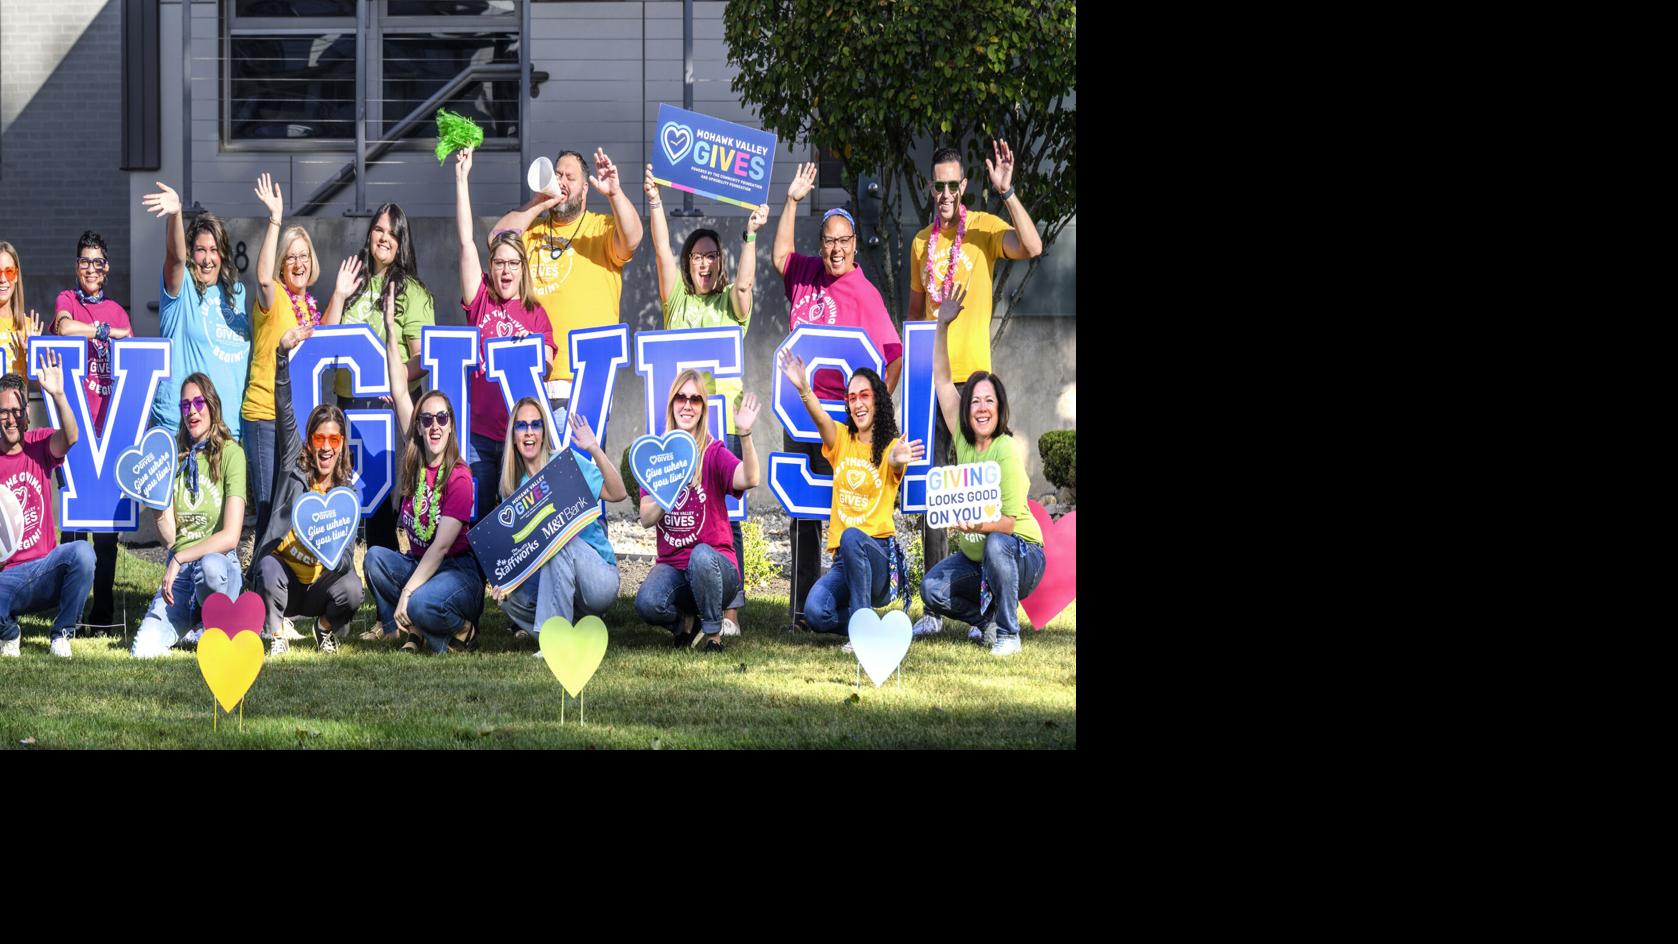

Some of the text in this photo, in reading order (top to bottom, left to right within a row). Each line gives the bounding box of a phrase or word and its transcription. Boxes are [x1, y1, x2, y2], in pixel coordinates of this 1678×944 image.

[697, 129, 768, 156] MOHAWK VALLEY
[694, 140, 766, 180] GIVES
[234, 240, 249, 273] 8
[90, 361, 112, 374] GIVE
[134, 474, 148, 494] Give
[148, 452, 170, 476] where
[144, 479, 158, 498] you
[156, 462, 170, 482] live!
[646, 460, 688, 483] Give where
[652, 468, 685, 492] you live!
[929, 466, 997, 490] GIVING
[512, 474, 545, 505] MOHAWK VALLEY
[514, 480, 550, 516] GIVES
[840, 493, 868, 508] GIVES
[929, 489, 998, 506] LOOKS GOOD
[541, 512, 566, 540] M&T
[563, 496, 588, 520] Bank
[664, 515, 695, 527] GIVES
[930, 506, 982, 525] ON YOU
[18, 528, 42, 550] EGIN!
[308, 517, 350, 540] Give where
[316, 526, 348, 550] you live!
[664, 532, 698, 548] BEGIN!
[494, 540, 540, 580] Staffworks
